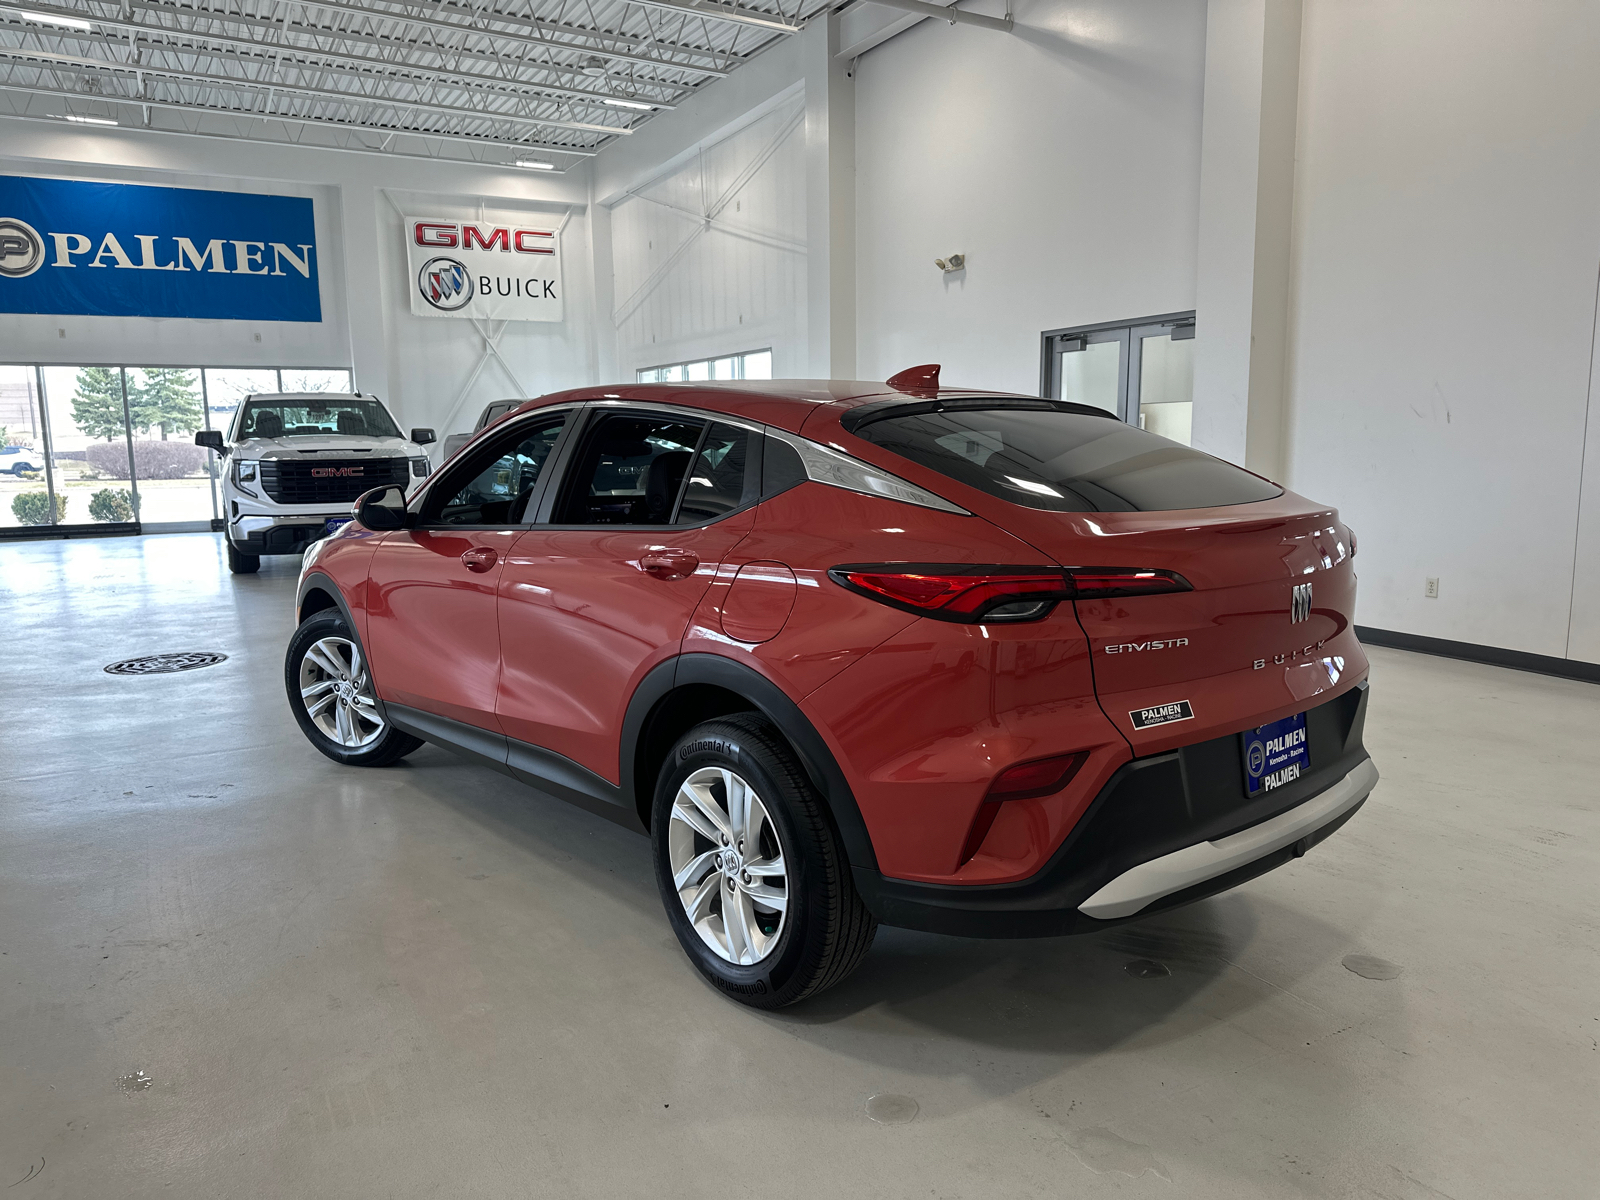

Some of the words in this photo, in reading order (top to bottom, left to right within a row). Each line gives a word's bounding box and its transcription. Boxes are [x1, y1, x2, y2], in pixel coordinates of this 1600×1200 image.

[414, 221, 555, 256] GMC
[48, 232, 313, 279] PALMEN
[480, 276, 556, 299] BUICK
[312, 467, 364, 477] GMC
[1105, 638, 1188, 654] ENVISTA
[1253, 639, 1325, 670] BUICK
[1141, 704, 1181, 720] PALMEN
[680, 740, 726, 760] Continental
[1266, 727, 1305, 756] PALMEN
[1269, 753, 1288, 765] Kenosha
[1290, 747, 1304, 757] Racine
[1265, 763, 1299, 792] PALMEN
